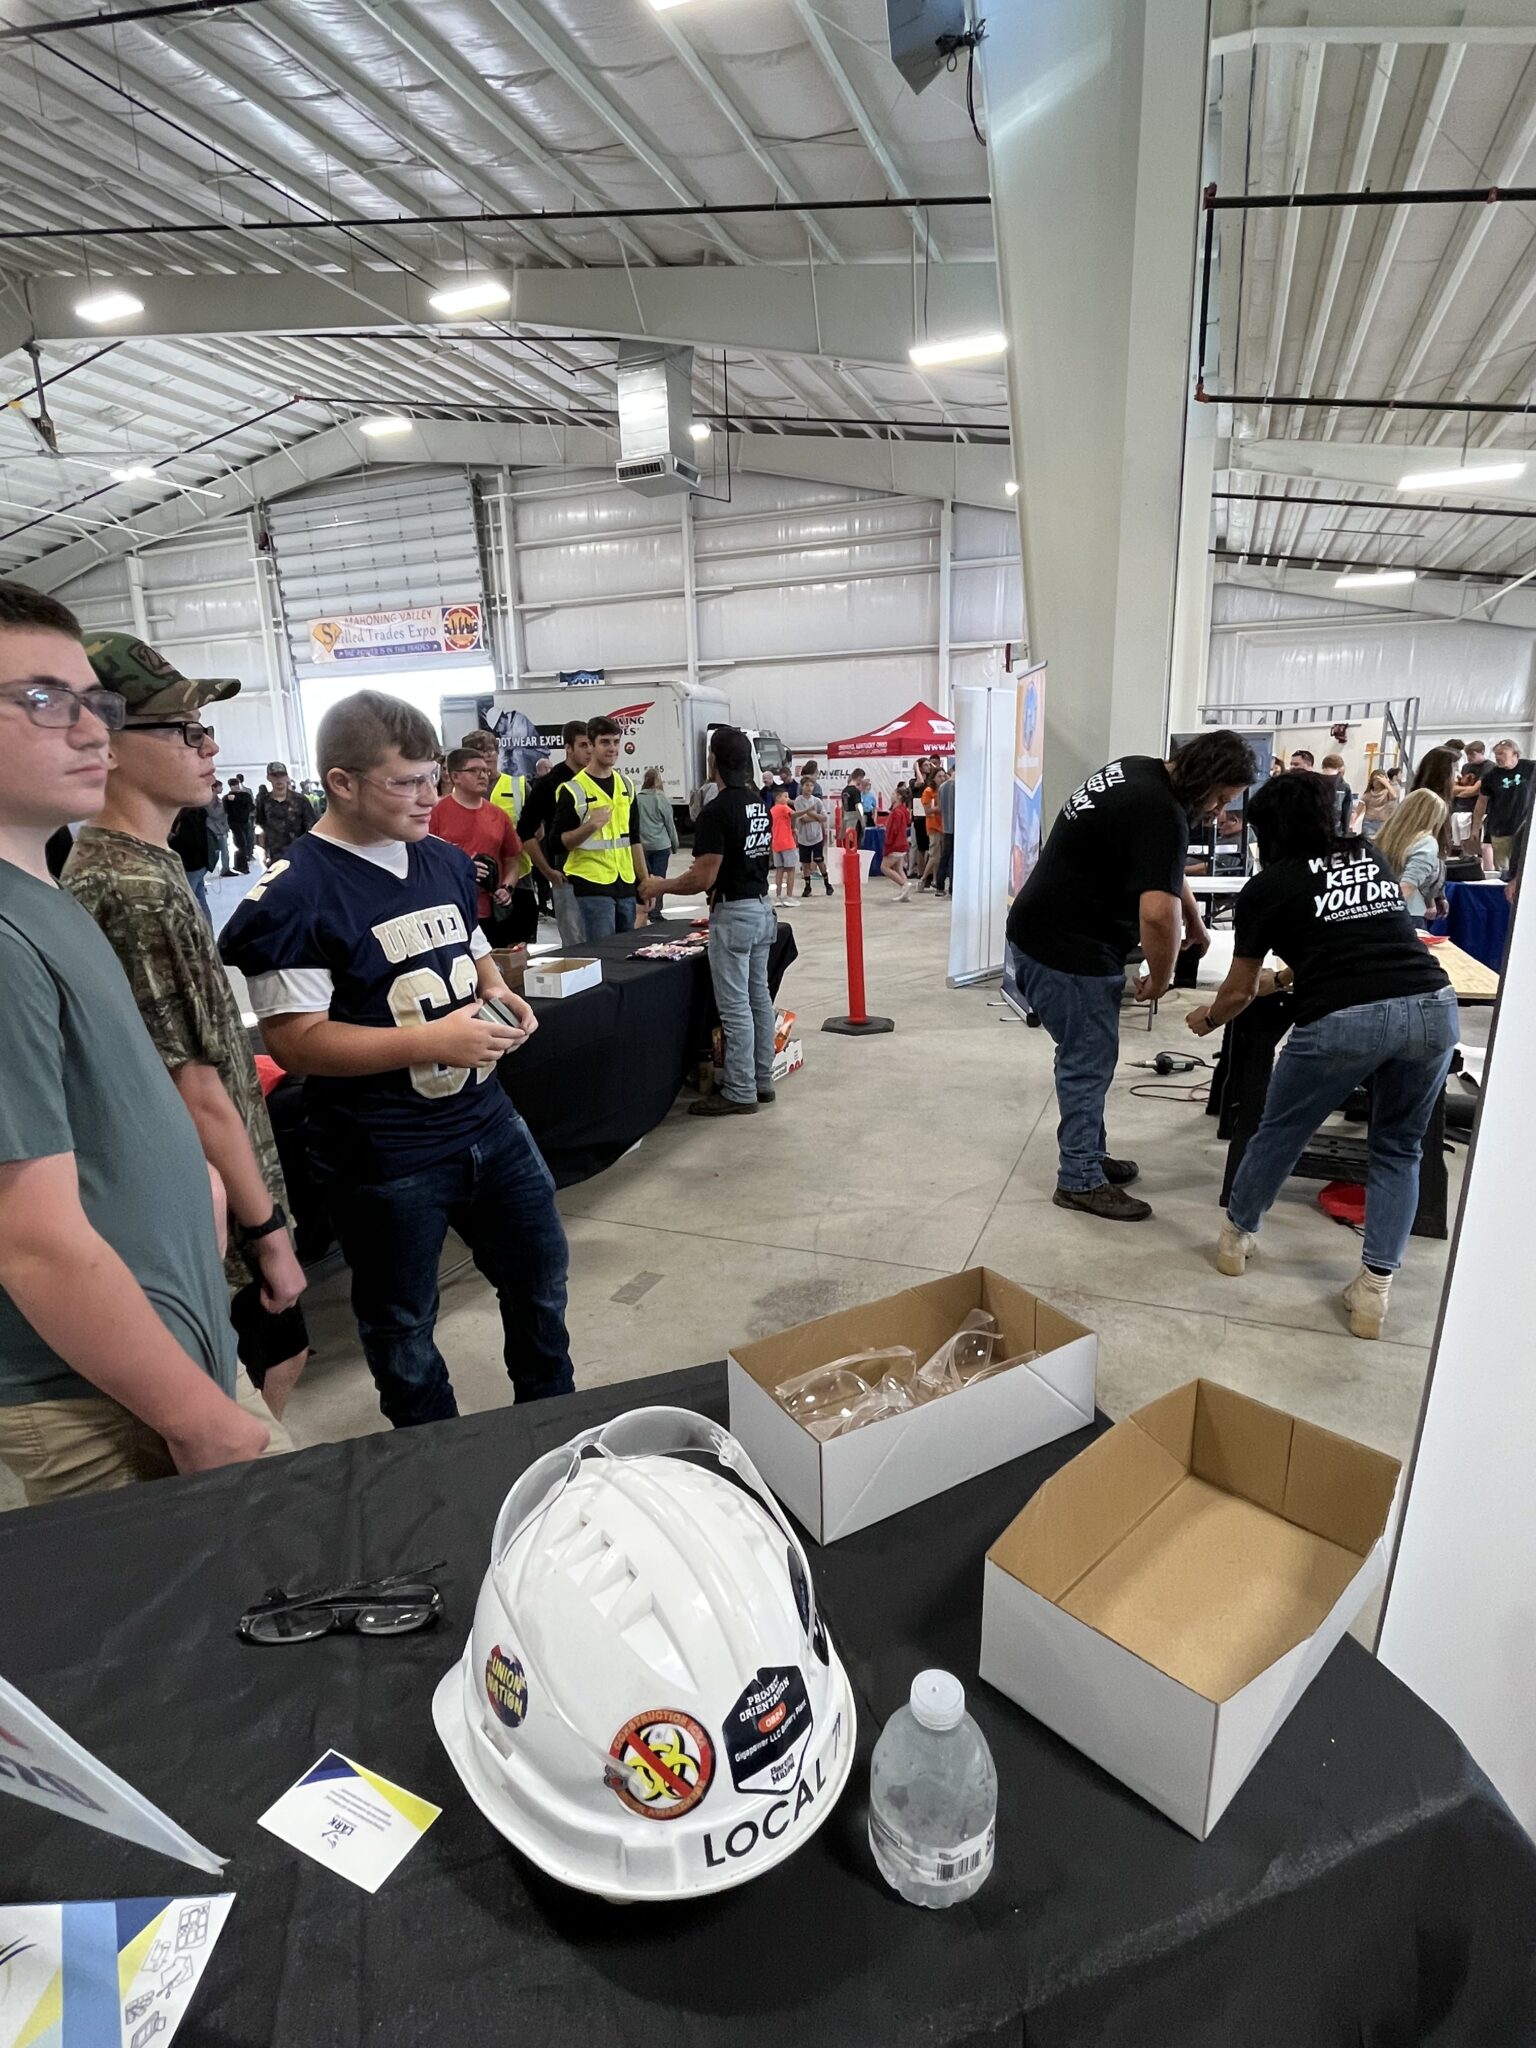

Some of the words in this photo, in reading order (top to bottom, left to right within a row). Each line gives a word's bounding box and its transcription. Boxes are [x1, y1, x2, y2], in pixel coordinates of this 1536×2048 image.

[344, 613, 397, 626] MAHONING
[399, 609, 432, 621] VALLEY
[322, 622, 365, 647] Skilled
[368, 627, 405, 643] Trades
[407, 623, 437, 640] Expo
[614, 716, 645, 725] WING
[624, 767, 640, 775] 544
[1326, 864, 1380, 889] KEEP
[1314, 884, 1361, 917] YOU
[1366, 881, 1400, 901] DRY
[1324, 904, 1368, 922] ROOFERS
[1370, 900, 1395, 910] LOCAL
[492, 1656, 526, 1696] UNION
[486, 1672, 523, 1717] NATION
[739, 1676, 790, 1722] ORIENTATION
[614, 1710, 688, 1750] CONSTRUCTION
[769, 1729, 782, 1742] LLC
[703, 1758, 826, 1867] LOCAL
[327, 1816, 356, 1837] LARK
